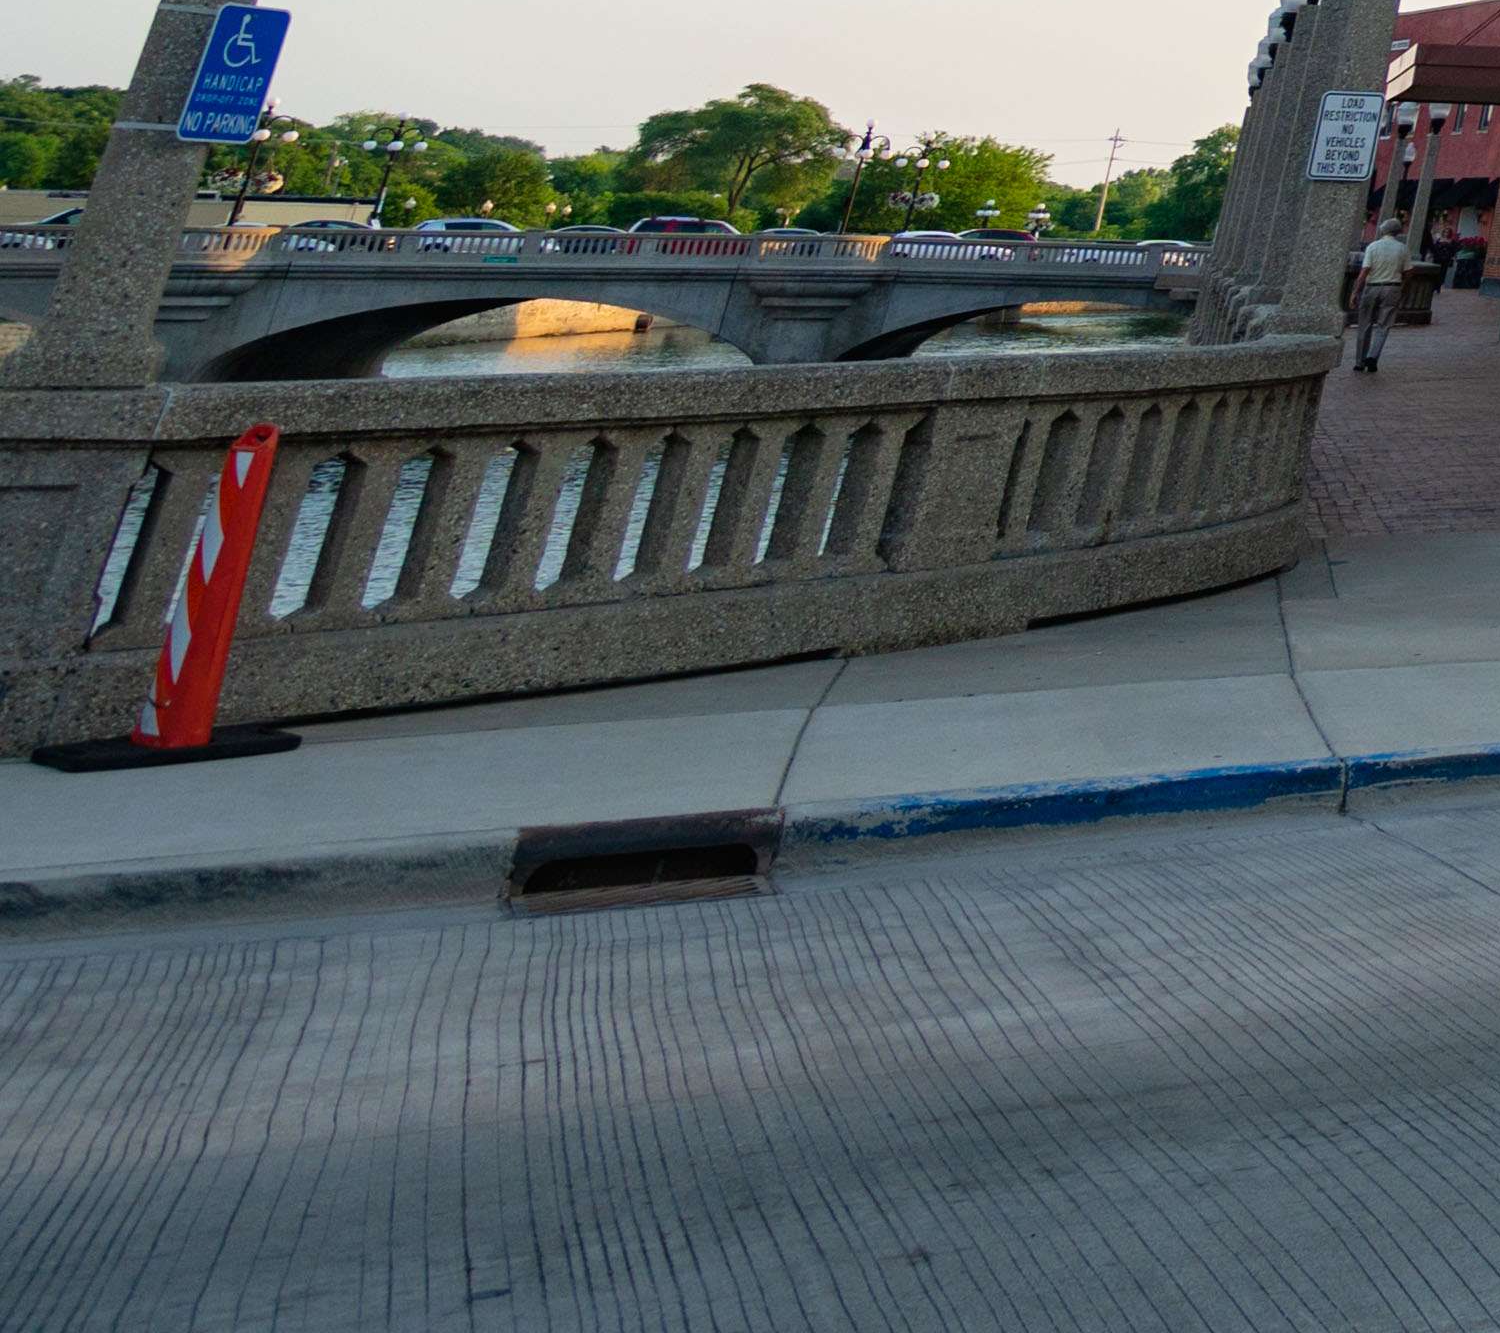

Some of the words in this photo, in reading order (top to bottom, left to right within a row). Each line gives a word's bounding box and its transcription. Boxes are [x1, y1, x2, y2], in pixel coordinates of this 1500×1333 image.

[203, 73, 264, 92] HANDICAP
[1342, 98, 1365, 109] LOAD
[1324, 110, 1378, 122] RESTRICTION
[183, 111, 202, 132] NO
[203, 112, 256, 135] PARKING
[1342, 124, 1354, 134] NO
[1326, 136, 1366, 148] VEHICLES
[1325, 149, 1360, 161] BEYOND
[1316, 162, 1336, 173] THIS
[1340, 163, 1364, 174] POINT
